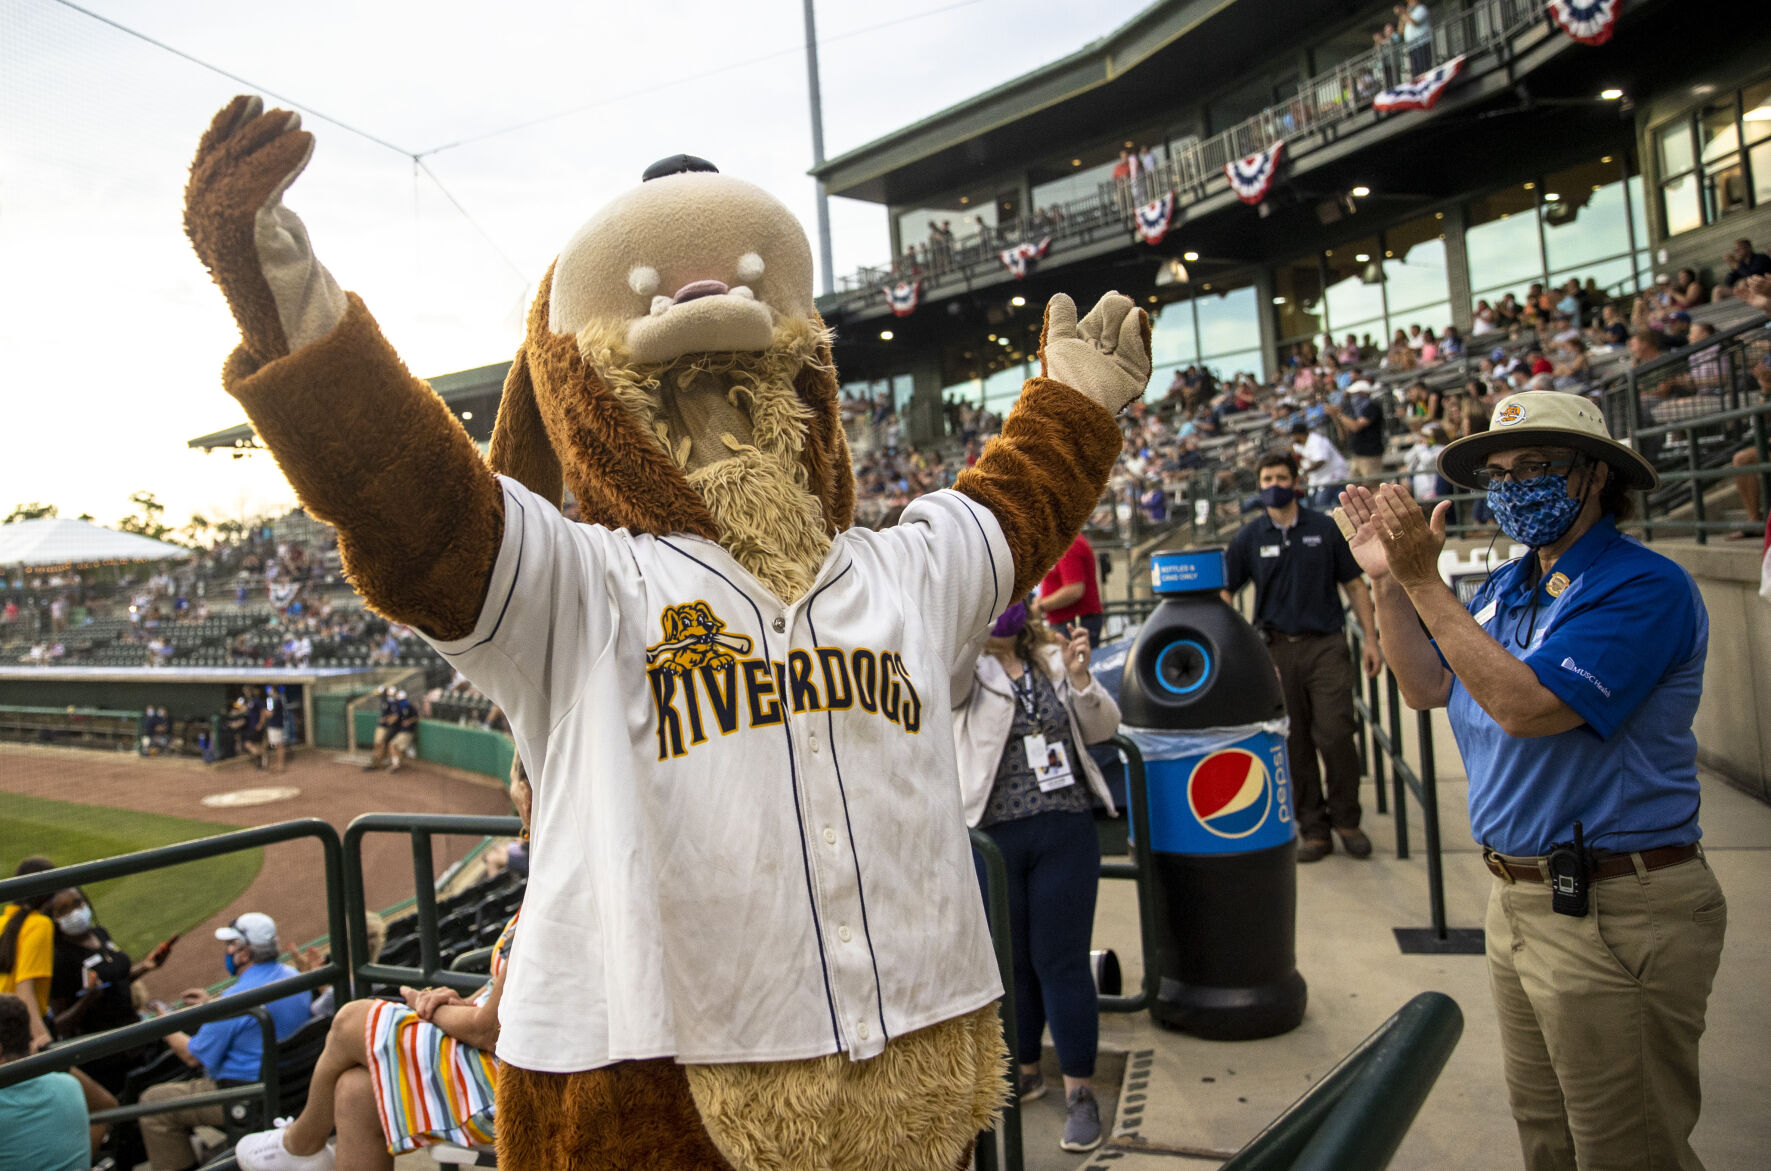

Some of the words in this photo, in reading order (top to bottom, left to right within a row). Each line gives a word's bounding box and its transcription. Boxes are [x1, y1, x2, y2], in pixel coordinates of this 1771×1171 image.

[647, 647, 922, 762] RIVERDOGS
[1573, 666, 1596, 683] MUSC
[1594, 680, 1611, 698] Health
[1270, 745, 1290, 823] pepsi
